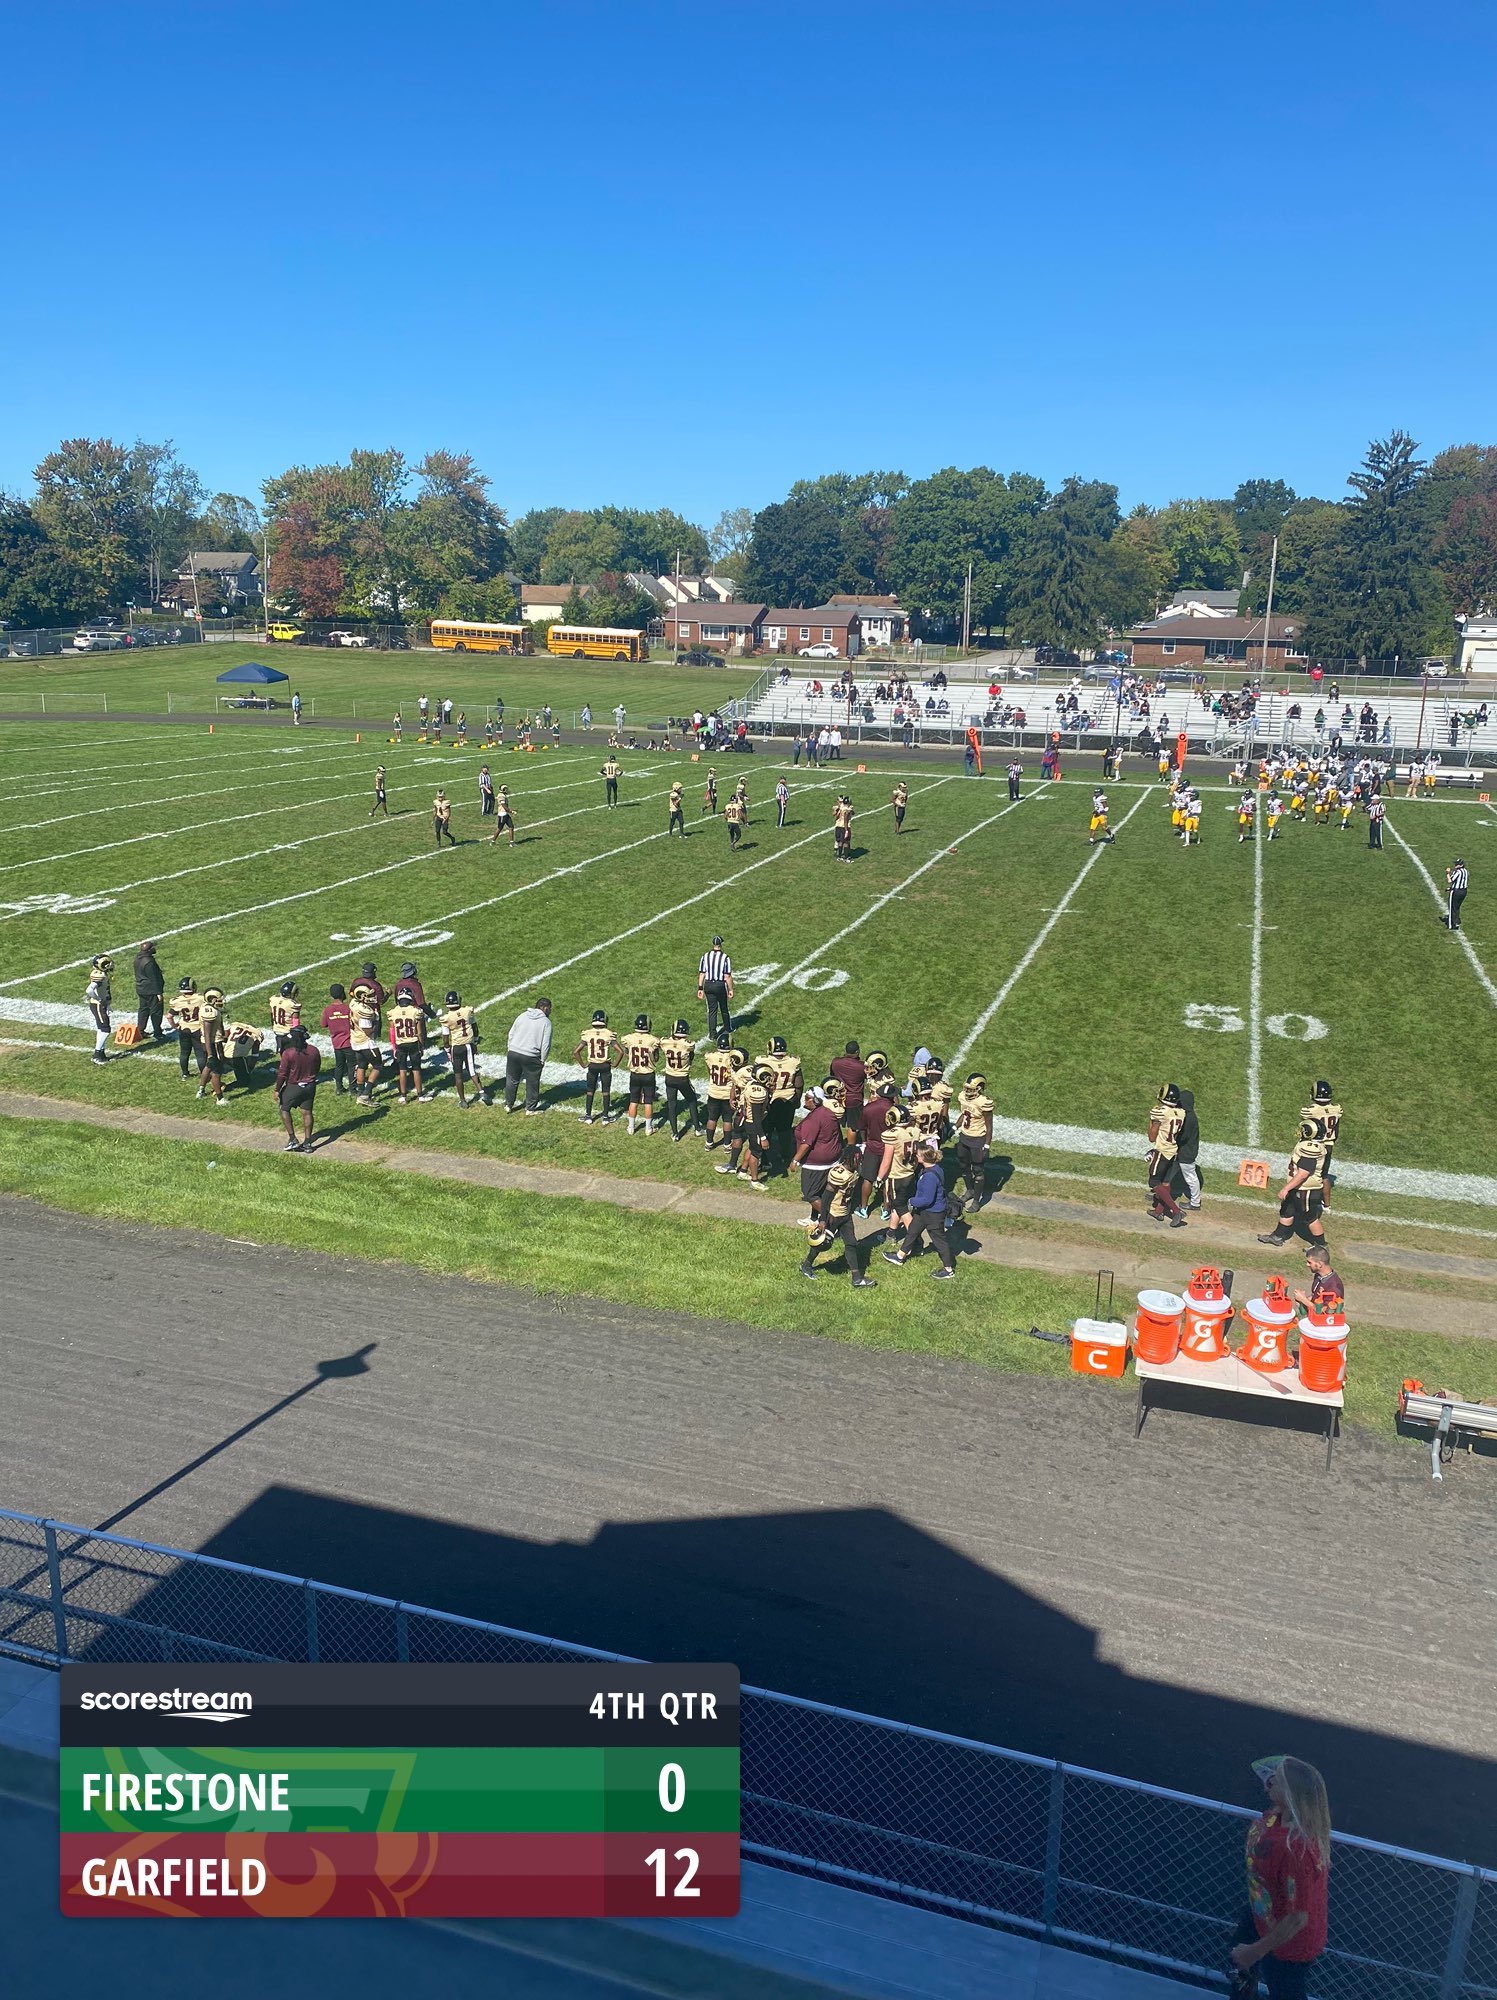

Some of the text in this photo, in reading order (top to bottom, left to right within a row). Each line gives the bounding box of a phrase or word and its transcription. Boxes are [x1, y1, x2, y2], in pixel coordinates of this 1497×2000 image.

[607, 766, 614, 775] 11
[727, 807, 737, 818] 20
[329, 925, 455, 949] 30
[394, 1018, 416, 1038] 28
[456, 1019, 468, 1037] 7
[1183, 1003, 1331, 1042] 50
[117, 1026, 133, 1043] 30
[589, 1038, 605, 1059] 13
[631, 1046, 649, 1067] 65
[666, 1049, 682, 1069] 21
[919, 1111, 941, 1134] 22
[1243, 1163, 1265, 1185] 50
[1205, 1290, 1213, 1299] G
[1194, 1320, 1212, 1338] G
[1326, 1316, 1335, 1325] G
[1258, 1330, 1277, 1349] G
